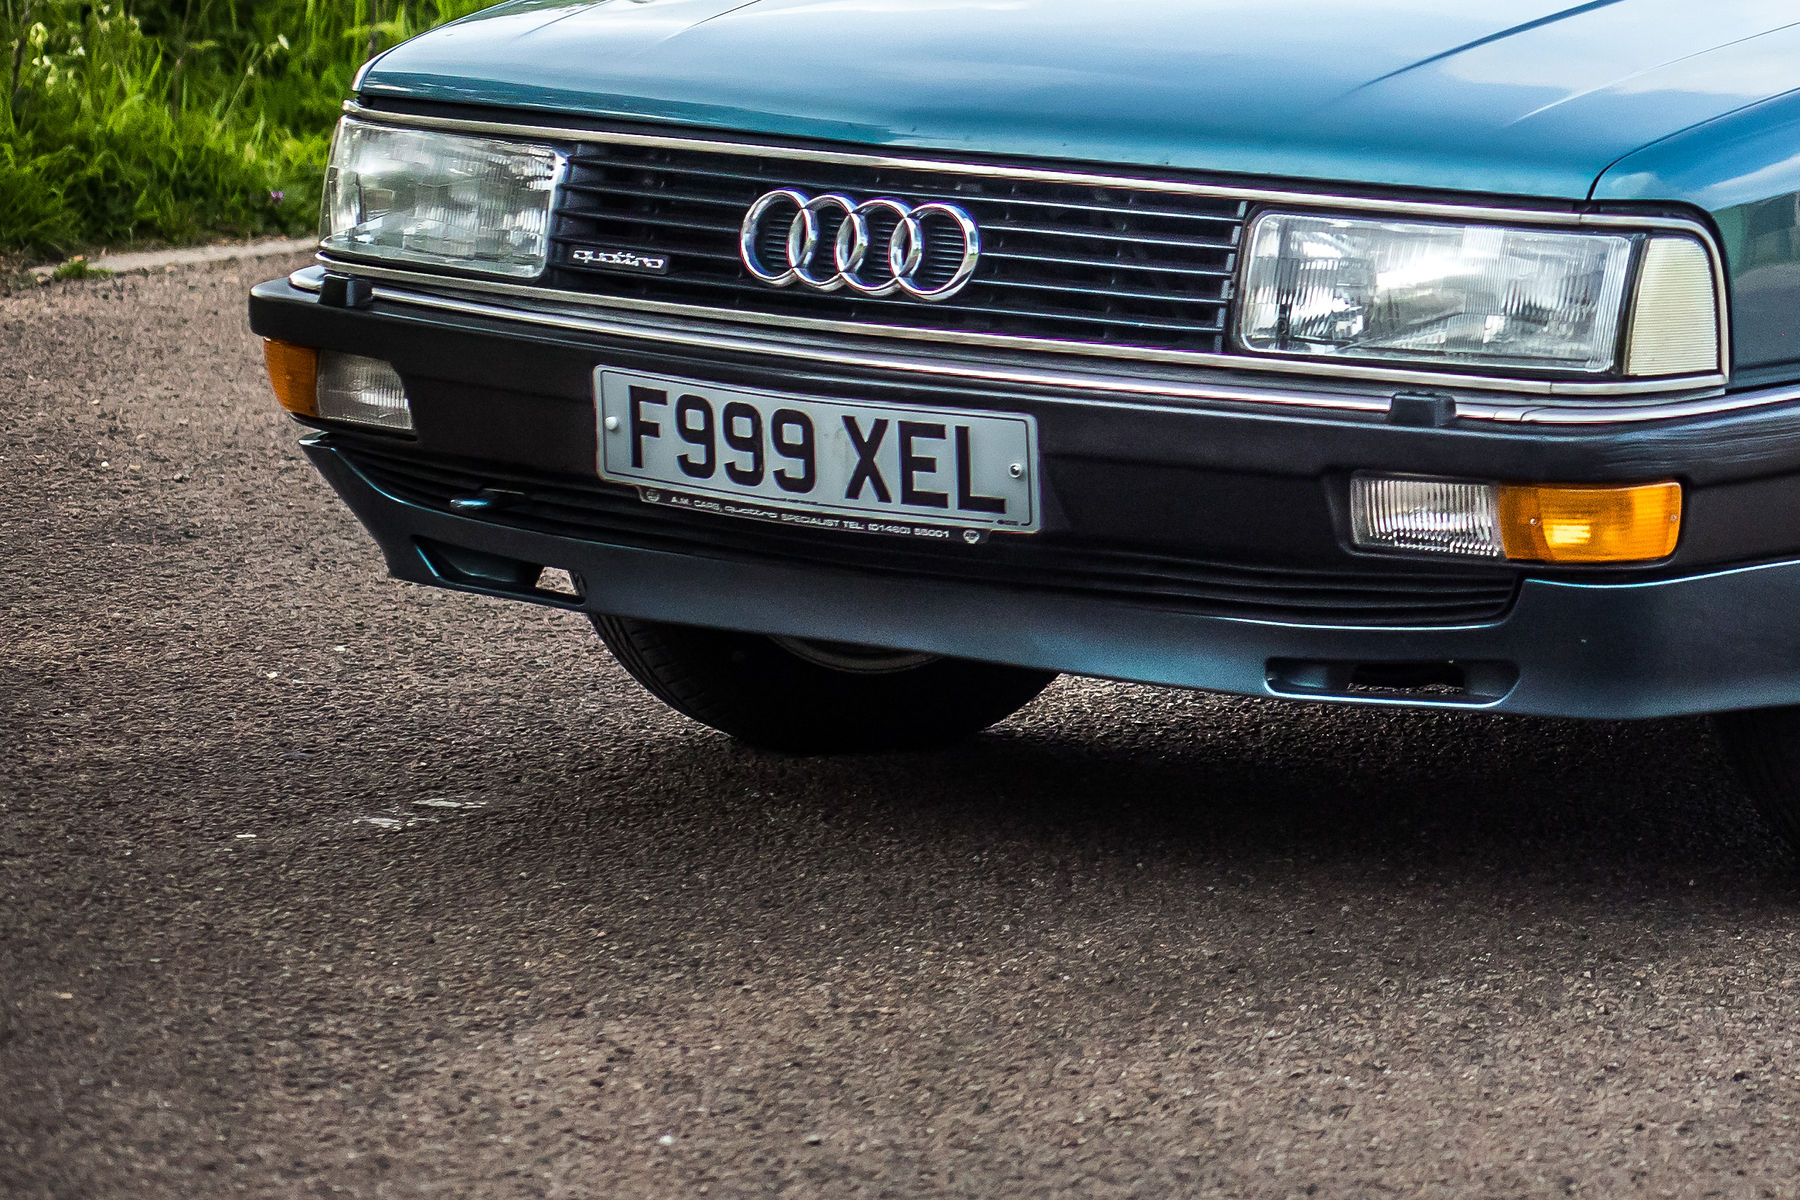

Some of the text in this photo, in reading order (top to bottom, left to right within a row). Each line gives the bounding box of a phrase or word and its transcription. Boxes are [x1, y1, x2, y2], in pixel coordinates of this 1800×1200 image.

[573, 250, 664, 269] quattro
[627, 384, 1007, 515] F999 XEL
[781, 513, 840, 527] SPECIALIST
